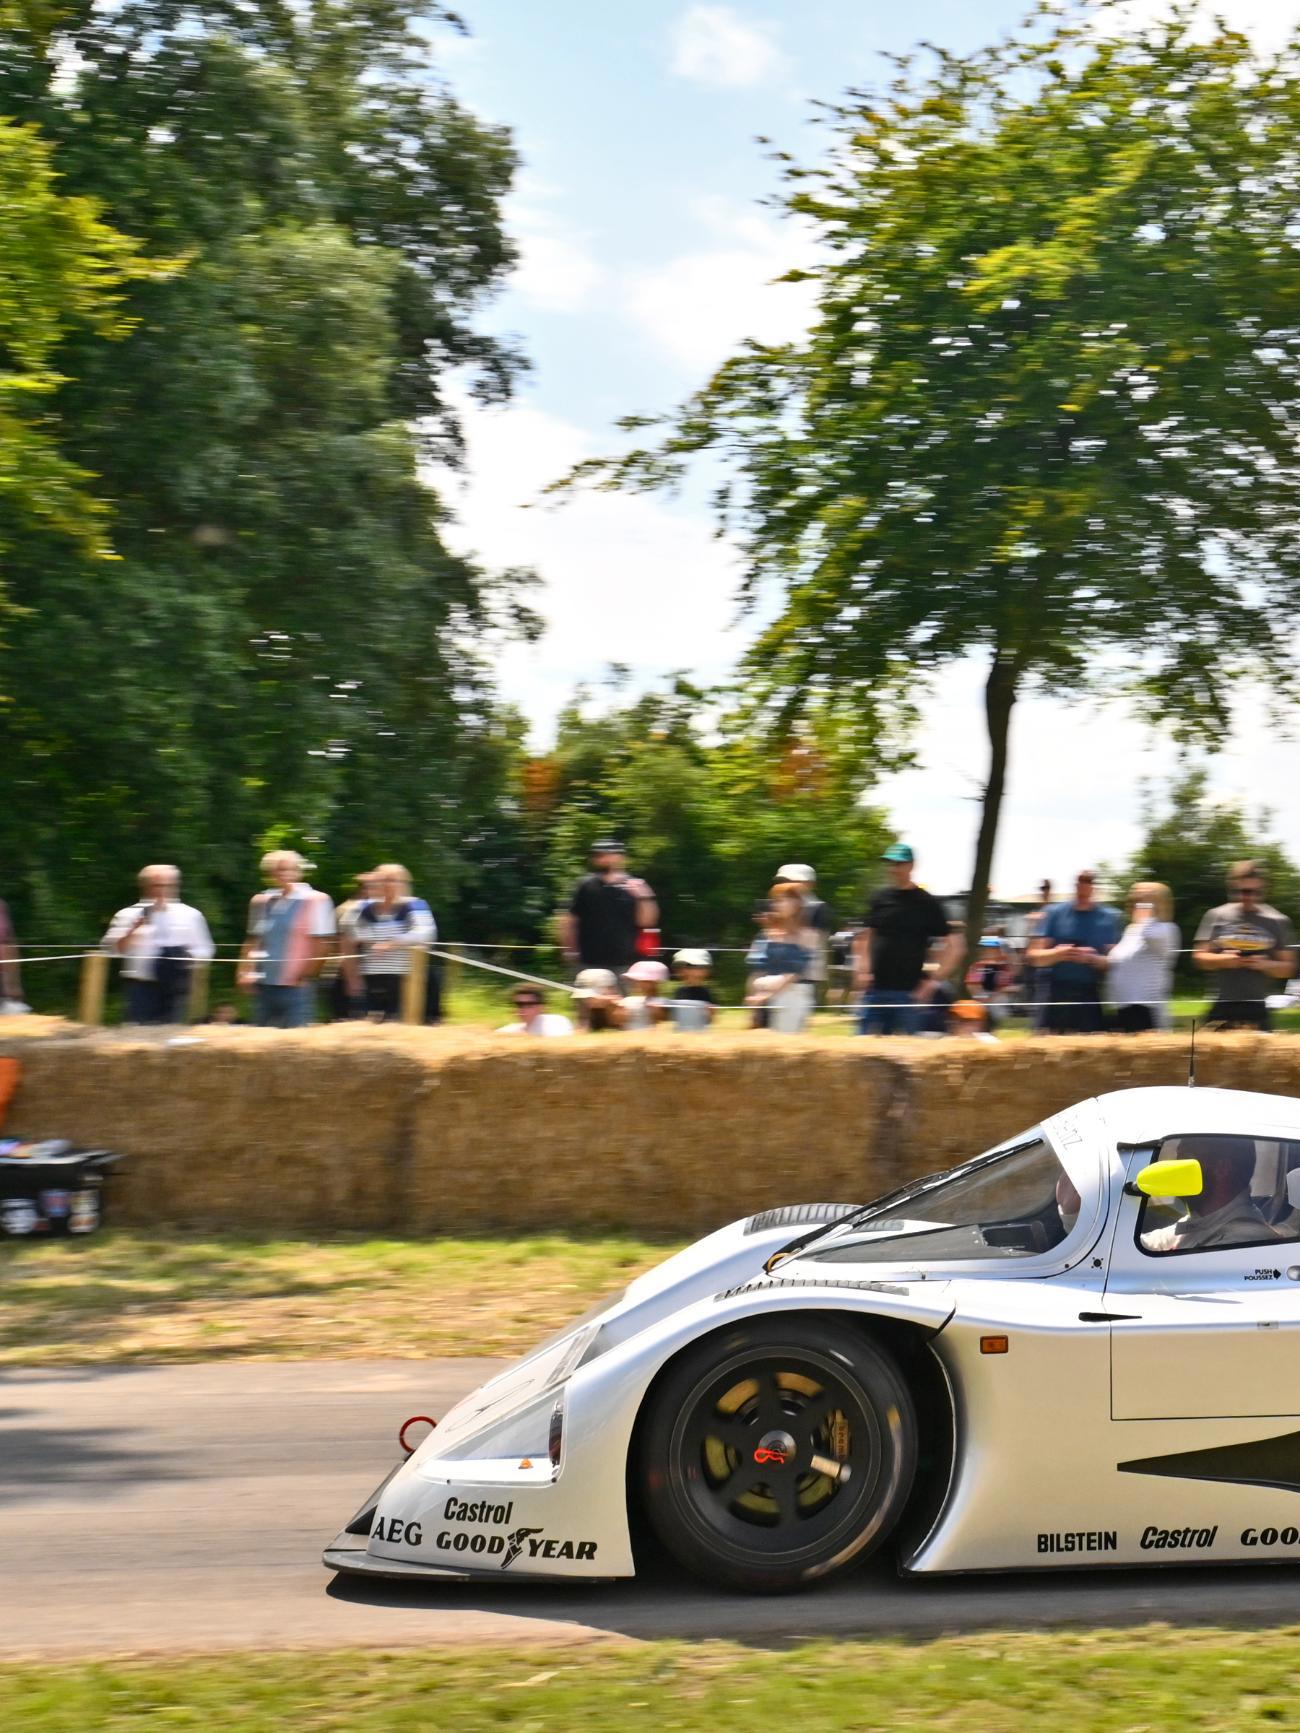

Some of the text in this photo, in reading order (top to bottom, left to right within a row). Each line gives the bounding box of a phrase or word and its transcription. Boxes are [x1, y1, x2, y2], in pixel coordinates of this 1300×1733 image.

[443, 1496, 514, 1525] Castrol
[371, 1515, 423, 1547] AEG
[1037, 1530, 1118, 1553] BILSTEIN
[1139, 1525, 1219, 1550] Castrol
